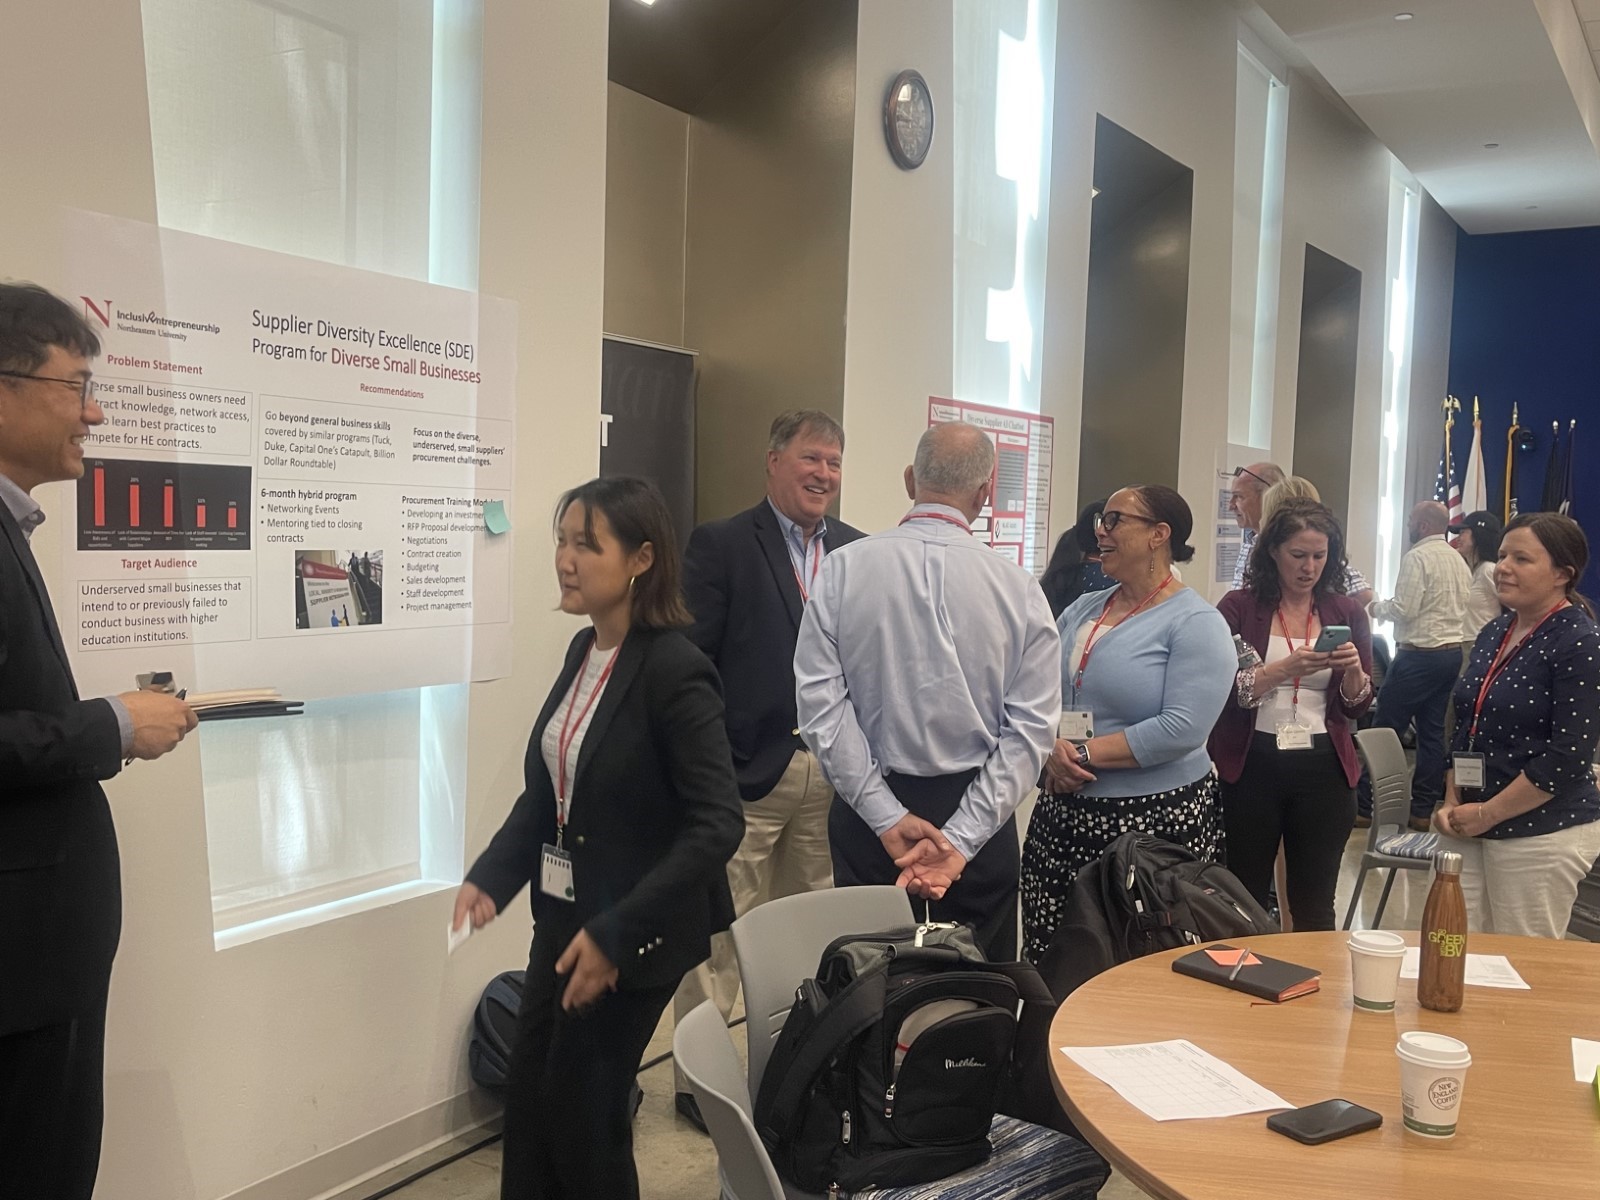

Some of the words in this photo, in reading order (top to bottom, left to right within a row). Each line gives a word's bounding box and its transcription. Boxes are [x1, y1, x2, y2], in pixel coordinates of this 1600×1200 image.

[117, 323, 156, 336] Northeastern
[158, 329, 187, 342] University
[252, 309, 313, 335] Supplier
[317, 319, 375, 348] Diversity
[378, 330, 441, 355] Excellence
[444, 340, 474, 363] (SDE)
[107, 354, 150, 368] Problem
[153, 360, 203, 375] Statement
[252, 338, 307, 360] Program
[310, 346, 327, 362] for
[331, 347, 380, 370] Diverse
[383, 355, 416, 375] Small
[419, 361, 481, 384] Businesses
[117, 383, 144, 395] small
[146, 385, 187, 400] business
[189, 393, 222, 404] owners
[223, 395, 246, 405] need
[360, 383, 424, 399] Recommendations
[121, 400, 177, 416] knowledge,
[179, 407, 217, 418] network
[219, 411, 250, 423] access,
[112, 416, 138, 428] learn
[140, 417, 161, 429] best
[163, 420, 205, 434] practices
[207, 424, 217, 434] to
[265, 410, 277, 421] Go
[279, 411, 309, 424] beyond
[310, 416, 339, 426] general
[340, 417, 372, 429] business
[373, 421, 391, 431] skills
[85, 433, 121, 444] ompete
[124, 433, 137, 445] for
[140, 435, 154, 446] HE
[156, 437, 202, 449] contracts.
[264, 427, 297, 438] covered
[298, 428, 307, 440] by
[309, 430, 335, 440] similar
[336, 433, 370, 445] programs
[371, 434, 392, 446] (Tuck,
[413, 427, 433, 437] Focus
[433, 430, 443, 438] on
[444, 430, 455, 439] the
[456, 431, 481, 443] diverse,
[264, 441, 287, 453] Duke,
[289, 442, 316, 455] Capital
[373, 449, 396, 459] Billion
[412, 441, 457, 452] underserved,
[457, 444, 475, 453] small
[263, 456, 288, 466] Dollar
[290, 458, 336, 471] Roundtable)
[412, 453, 456, 463] procurement
[457, 456, 492, 467] challenges.
[260, 488, 296, 498] 6-month
[298, 489, 323, 501] hybrid
[324, 492, 357, 502] program
[402, 496, 445, 505] Procurement
[446, 497, 472, 508] Training
[267, 504, 313, 515] Networking
[315, 505, 340, 514] Events
[407, 509, 444, 520] Developing
[267, 519, 309, 529] Mentoring
[311, 519, 326, 528] tied
[327, 520, 336, 528] to
[337, 519, 363, 530] closing
[407, 522, 420, 530] RFP
[420, 523, 449, 532] Proposal
[266, 534, 304, 542] contracts
[407, 536, 448, 546] Negotiations
[406, 549, 435, 558] Contract
[435, 550, 462, 558] creation
[121, 558, 152, 571] Target
[154, 557, 198, 568] Audience
[406, 563, 439, 572] Budgeting
[81, 583, 145, 595] Underserved
[147, 582, 172, 593] small
[174, 581, 222, 593] businesses
[223, 580, 241, 591] that
[406, 576, 423, 585] Sales
[424, 575, 466, 585] development
[406, 589, 421, 598] Staff
[422, 588, 464, 598] development
[81, 601, 114, 612] intend
[117, 601, 126, 611] to
[129, 602, 140, 610] or
[143, 598, 191, 612] previously
[192, 597, 217, 608] failed
[218, 597, 228, 607] to
[406, 603, 429, 612] Project
[430, 601, 472, 611] management
[81, 617, 122, 629] conduct
[124, 615, 165, 627] business
[167, 613, 188, 624] with
[190, 612, 219, 625] higher
[81, 633, 131, 645] education
[133, 630, 189, 643] institutions.
[1428, 931, 1466, 945] GREEN
